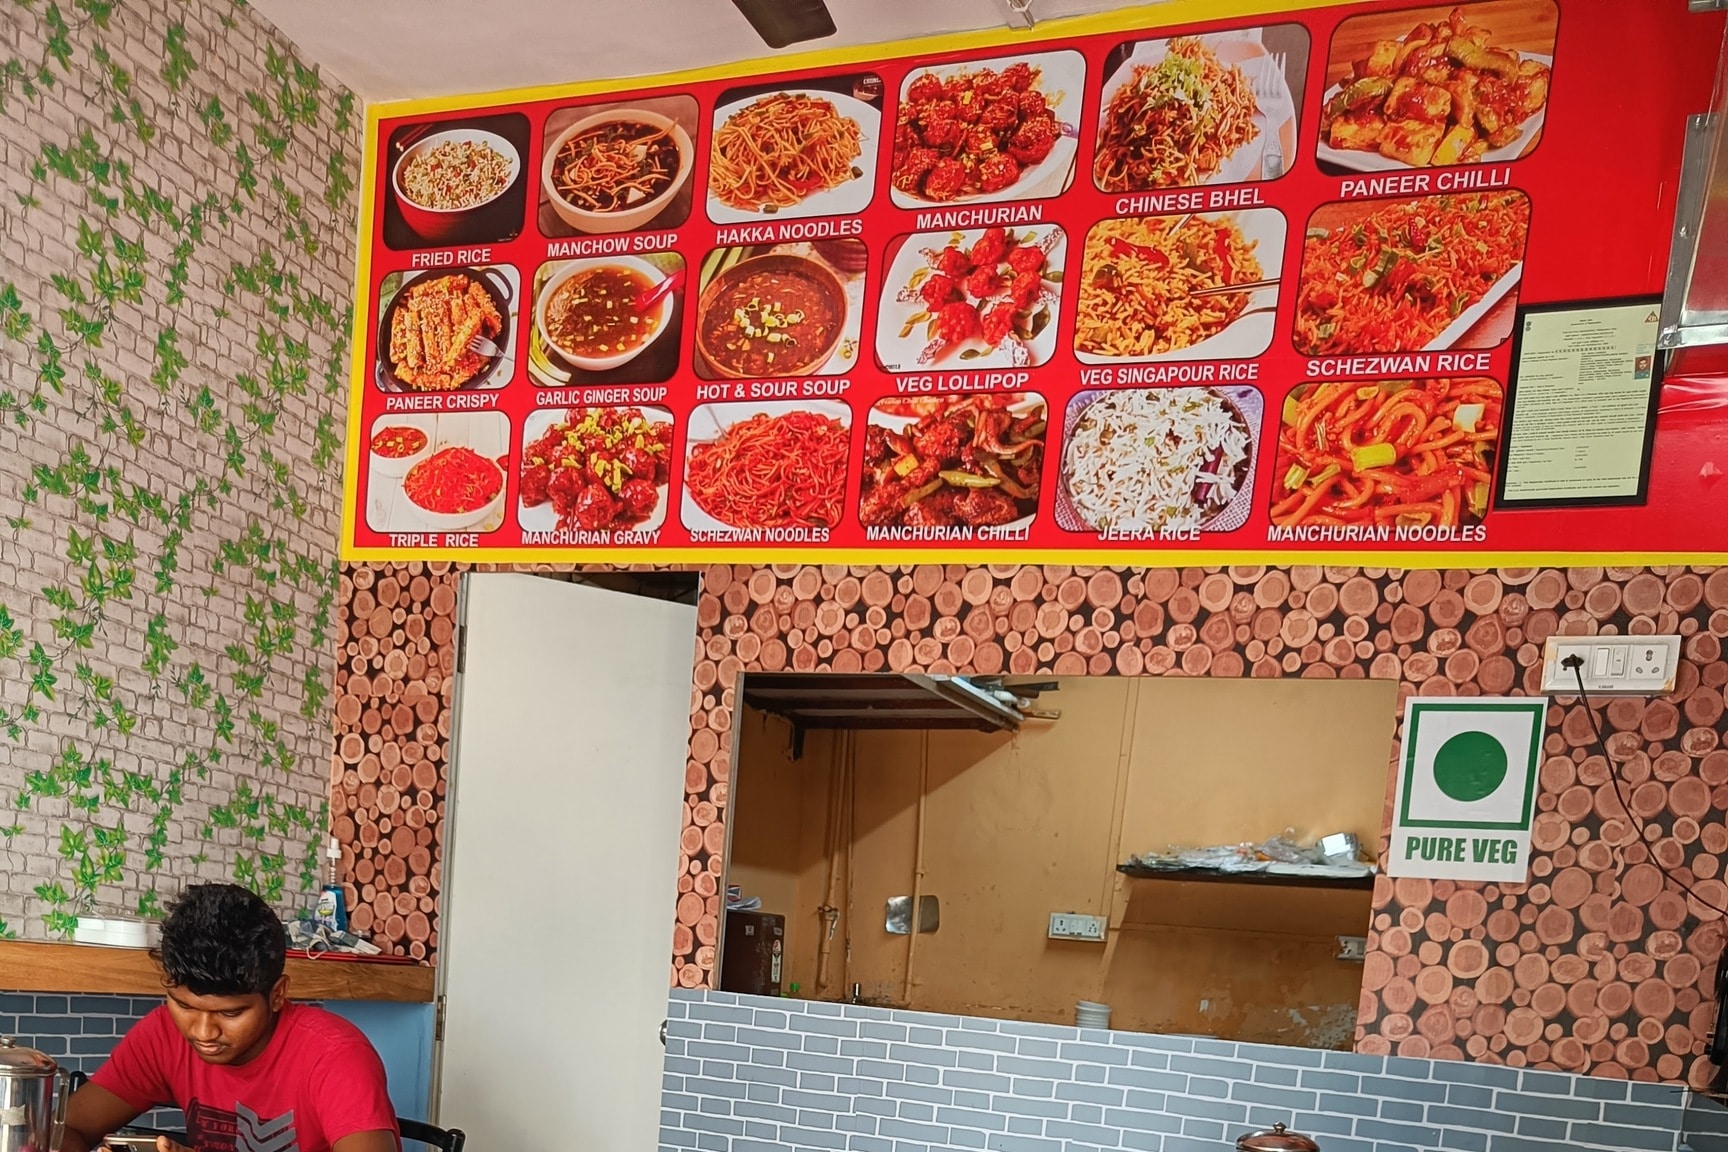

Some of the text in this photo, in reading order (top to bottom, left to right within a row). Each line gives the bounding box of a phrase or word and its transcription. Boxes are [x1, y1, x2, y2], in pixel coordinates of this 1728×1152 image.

[1340, 167, 1511, 198] PANEER CHILLI
[1115, 187, 1265, 215] CHINESE BHEL
[915, 205, 1043, 229] MANCHURIAN
[716, 219, 863, 245] HAKKA NOODLES
[547, 235, 678, 257] MANCHOW SOUP
[411, 248, 492, 267] FRIED RICE
[1080, 363, 1259, 385] VEG SINGAPOUR RICE
[1306, 353, 1491, 377] SCHEZWAN RICE
[696, 379, 851, 400] HOT & SOUR SOUP
[896, 372, 1030, 393] VEG LOLLIPOP
[386, 393, 499, 410] PANEER CRISPY
[536, 386, 667, 406] GARLIC GINGER SOUP
[389, 533, 479, 547] TRIPLE RICE
[521, 530, 661, 545] MANCHURIAN GRAVY
[689, 527, 830, 542] SCHEZWAN NOODLES
[866, 525, 1031, 541] MANCHURIAN CHILLI
[1097, 526, 1201, 541] JEERA RICE
[1267, 525, 1487, 542] MANCHURIAN NOODLES
[1405, 836, 1518, 864] PURE VEG
